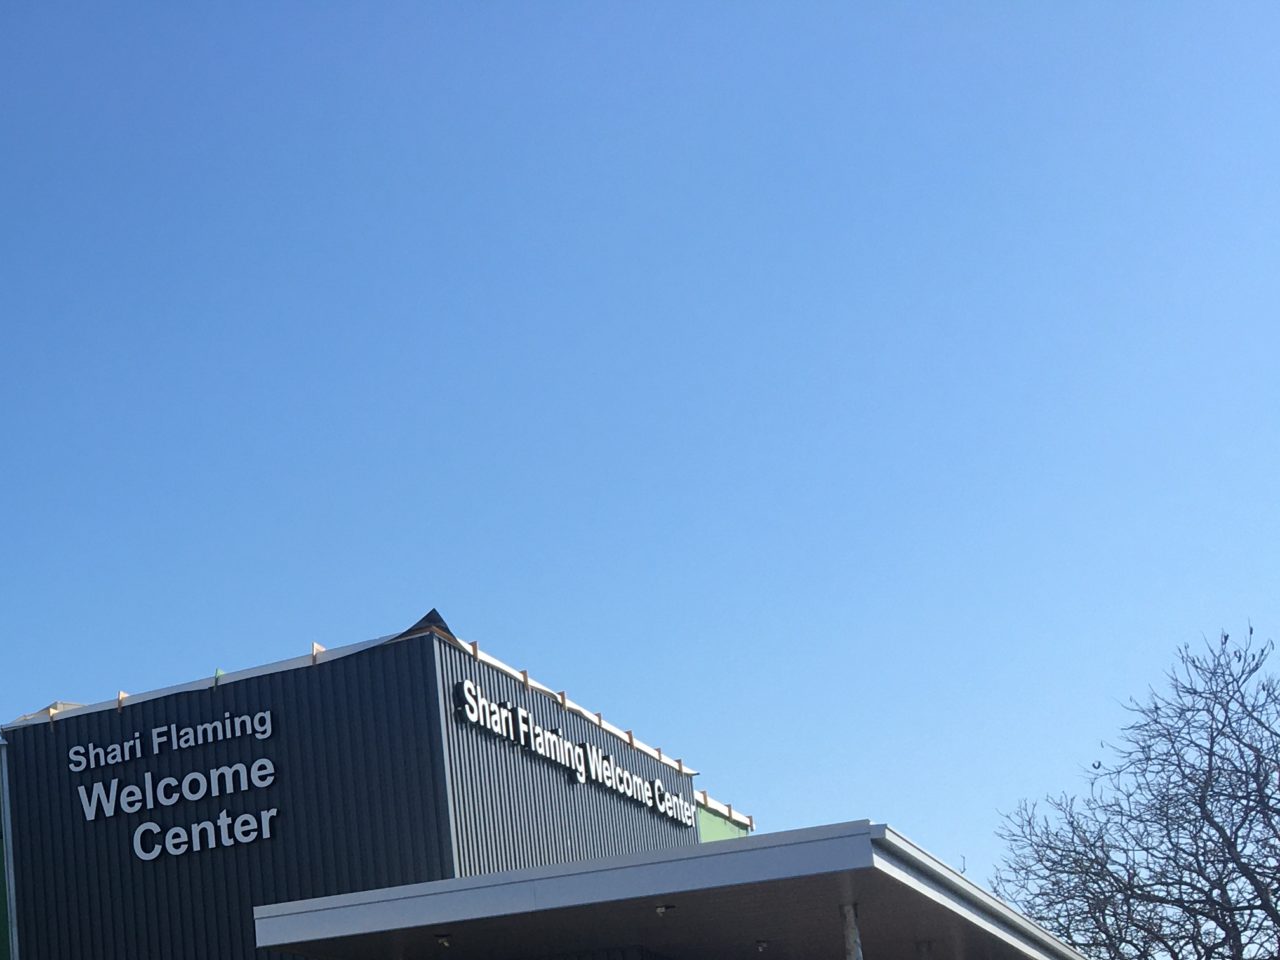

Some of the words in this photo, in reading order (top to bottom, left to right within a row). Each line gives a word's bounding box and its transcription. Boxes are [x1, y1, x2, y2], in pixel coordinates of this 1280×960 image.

[68, 731, 142, 772] Shari
[151, 710, 272, 755] Flaming
[463, 679, 516, 741] Shari
[517, 706, 586, 784] Flaming
[586, 742, 653, 808] Welcome
[654, 778, 696, 828] Center
[77, 757, 275, 822] Welcome
[132, 807, 278, 861] Center
